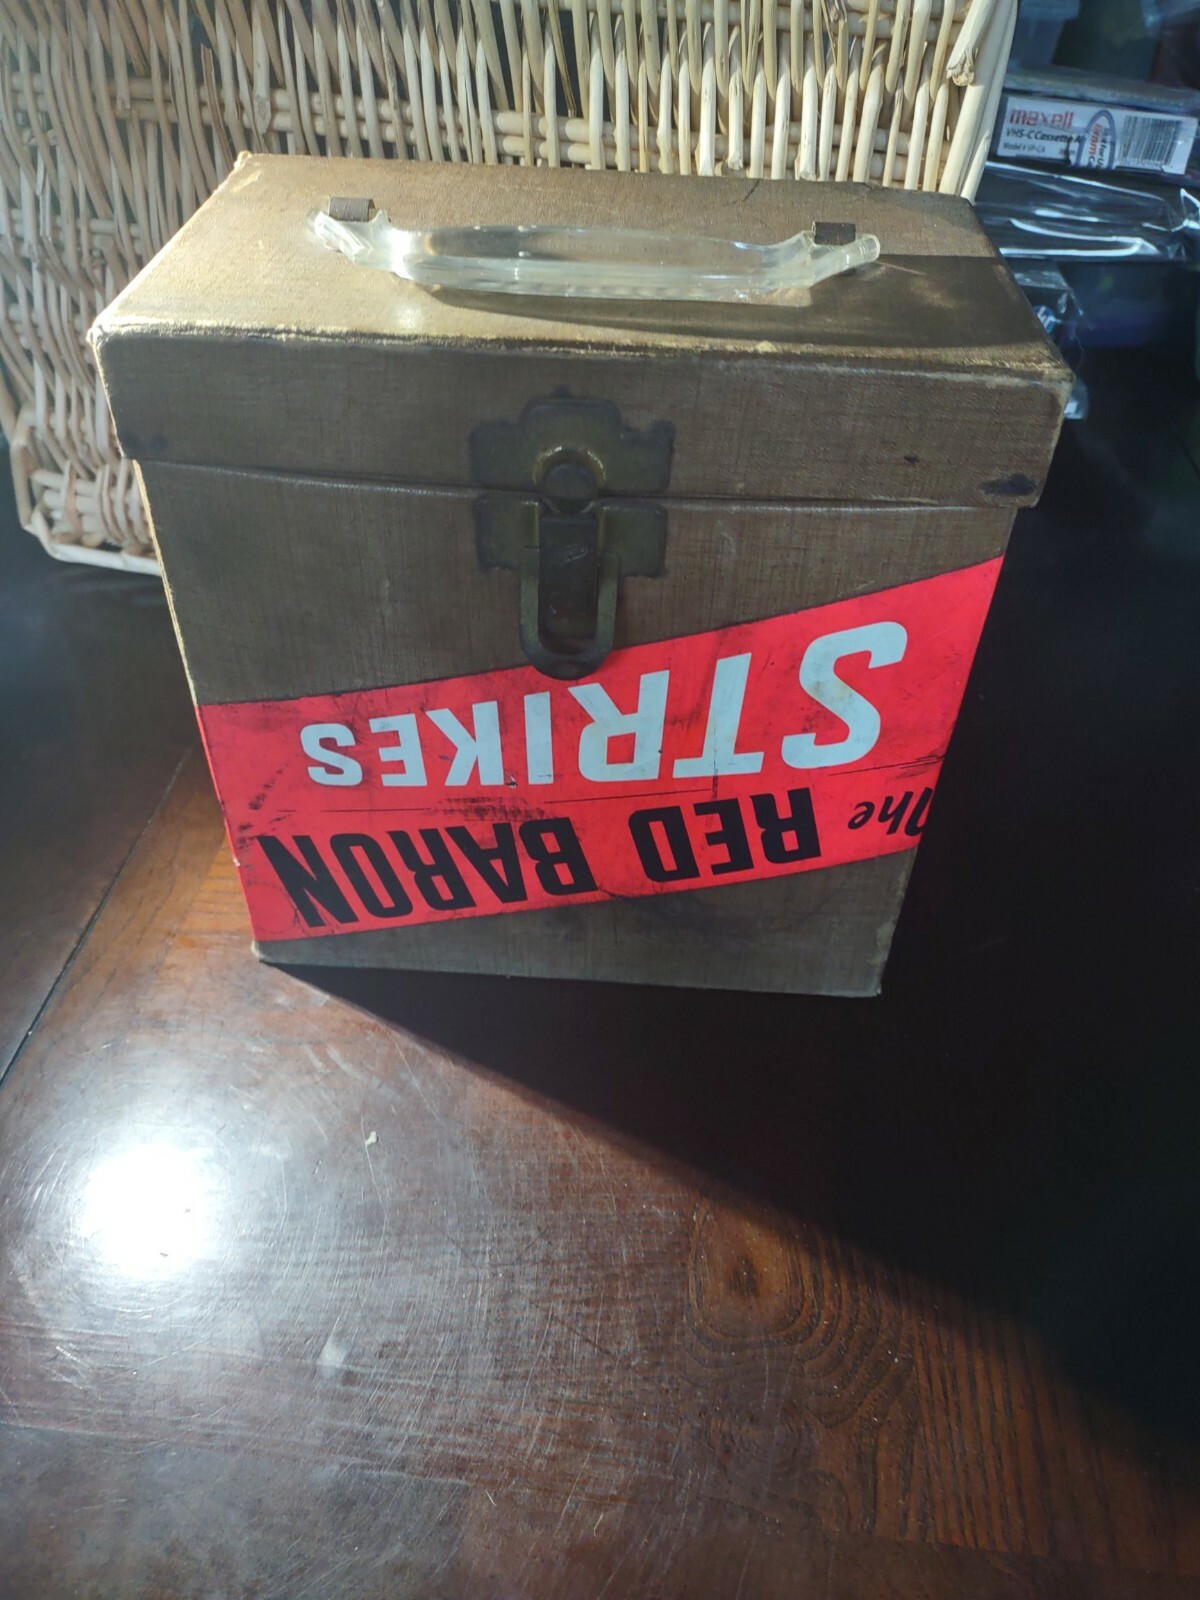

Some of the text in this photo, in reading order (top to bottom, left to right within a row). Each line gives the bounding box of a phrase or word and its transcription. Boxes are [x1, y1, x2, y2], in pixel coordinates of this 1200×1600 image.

[1006, 127, 1034, 139] VHS-C
[1009, 108, 1074, 130] maxell
[300, 621, 908, 788] STRIKES
[256, 816, 599, 928] BARON
[628, 787, 822, 883] RED
